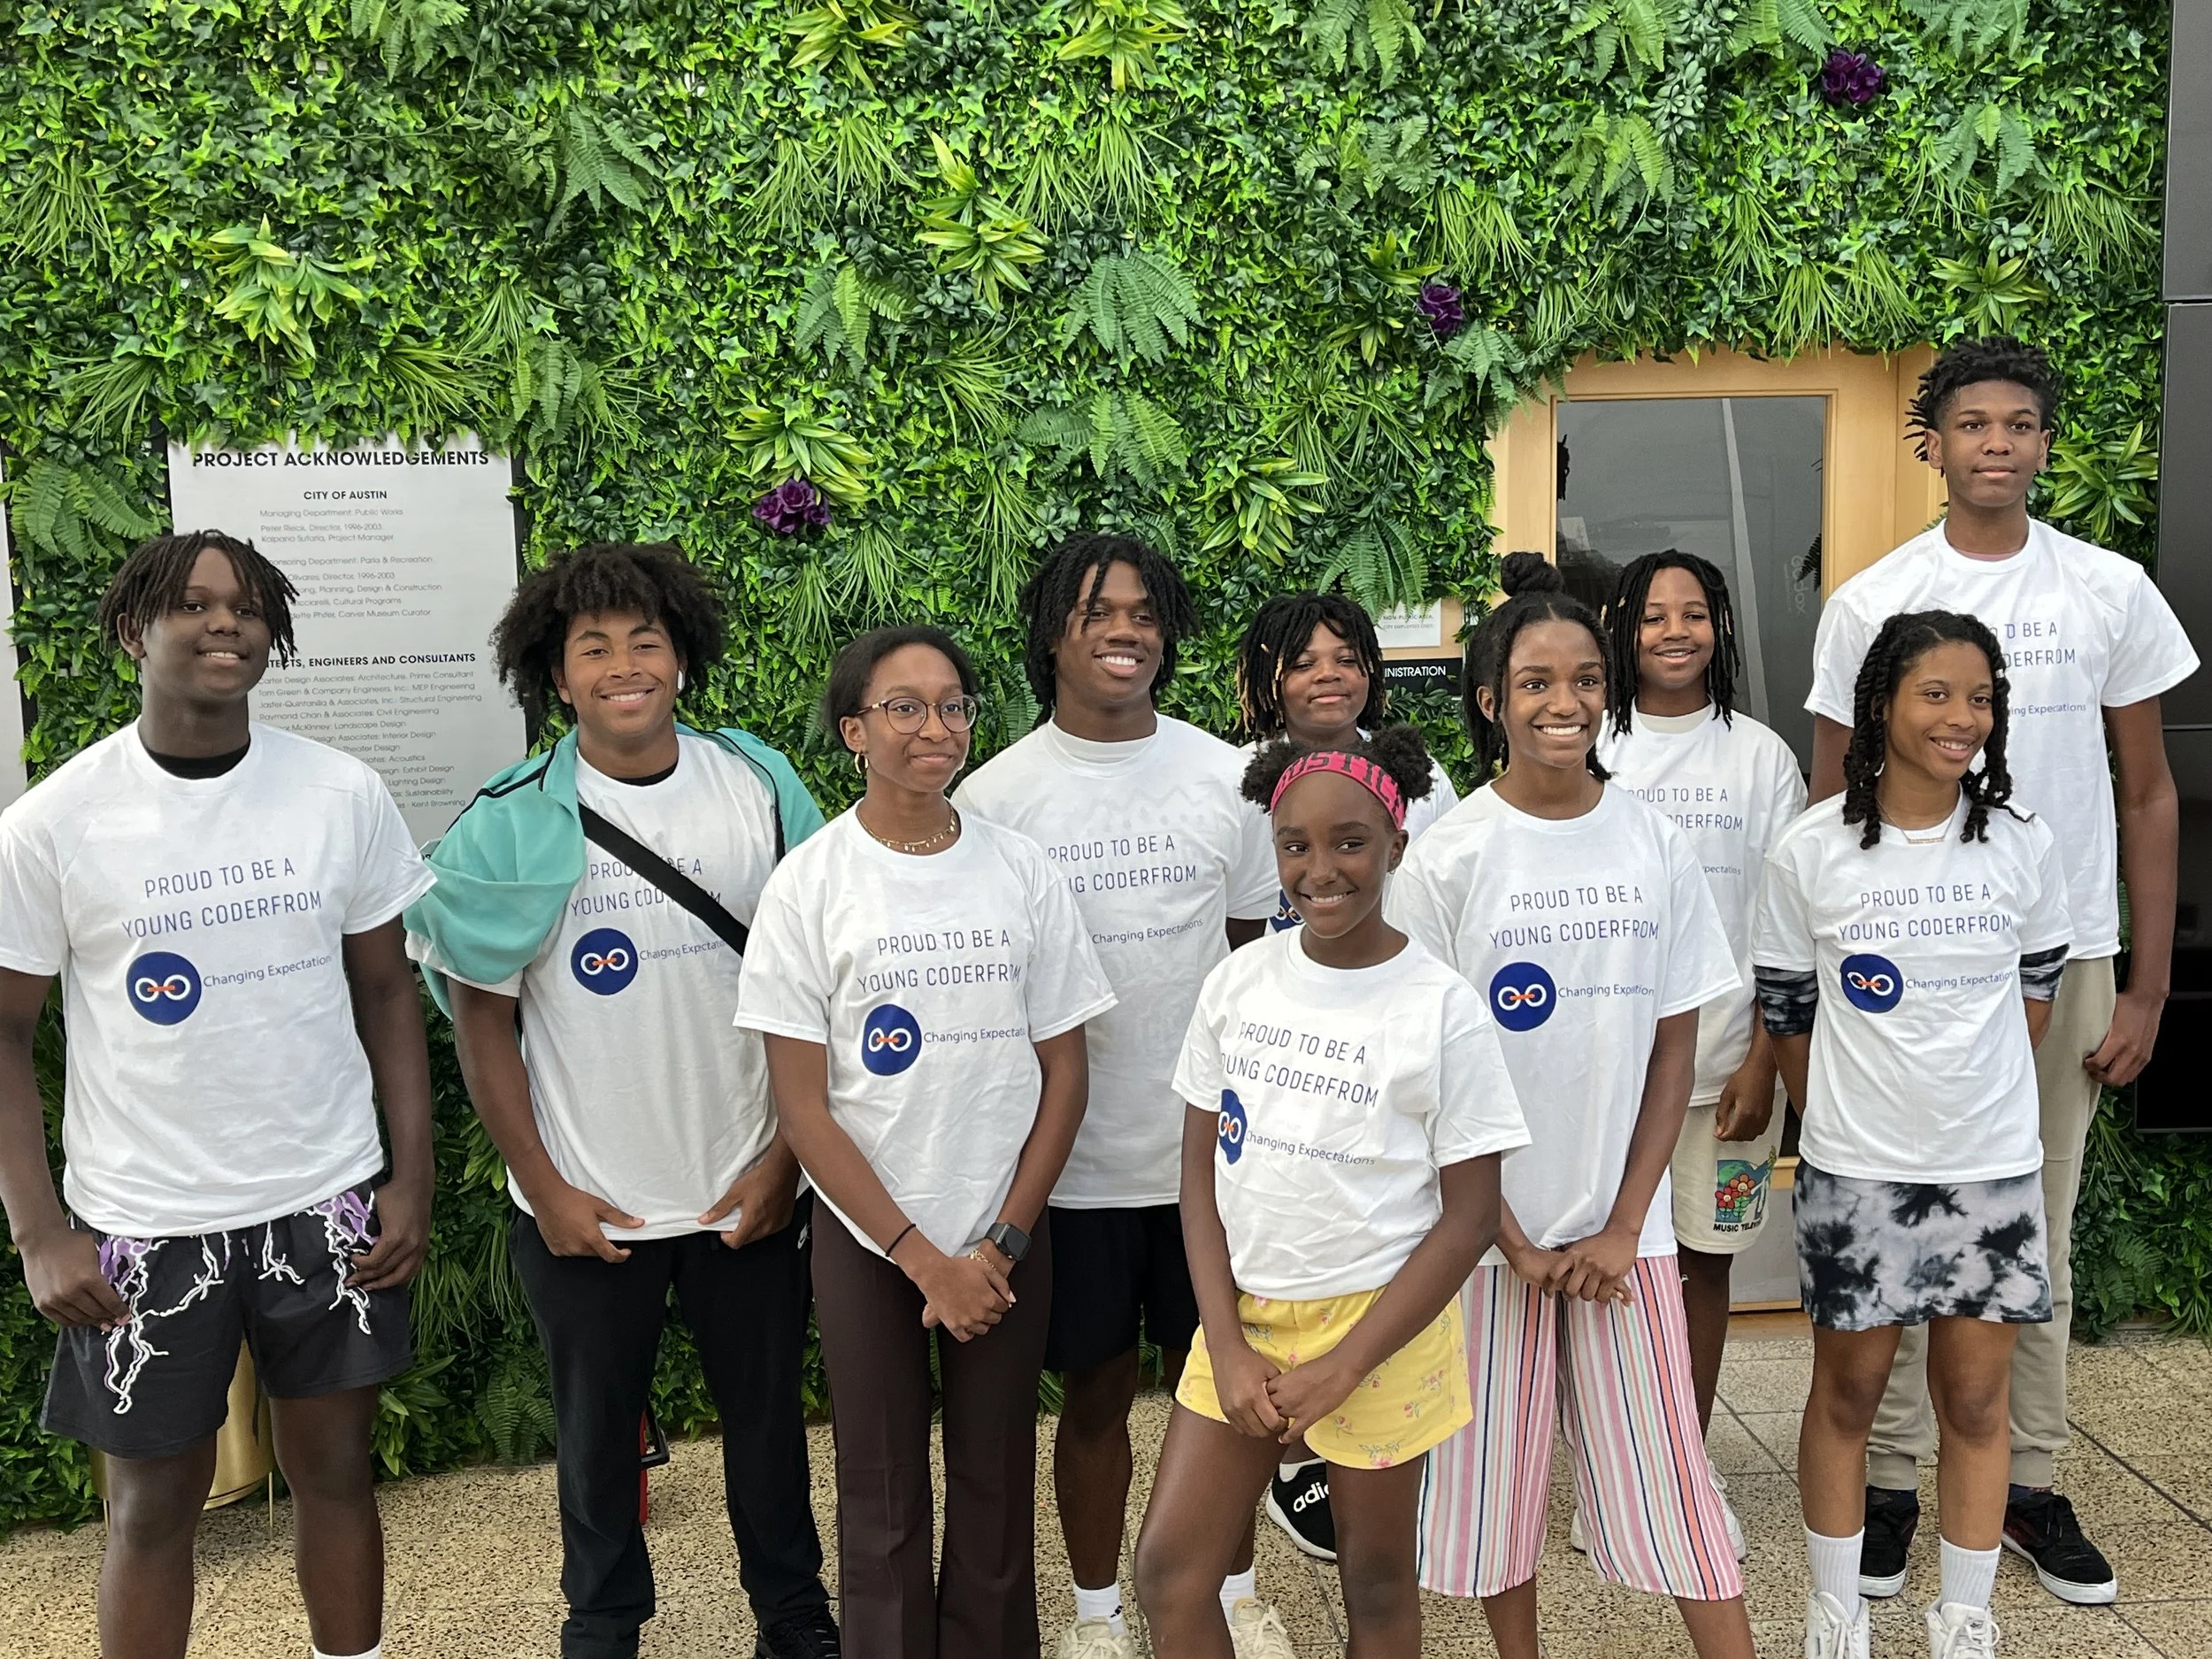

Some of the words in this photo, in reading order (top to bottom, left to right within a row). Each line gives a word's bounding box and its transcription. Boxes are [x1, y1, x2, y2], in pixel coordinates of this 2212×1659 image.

[193, 452, 278, 467] PROJECT
[284, 451, 488, 466] ACKNOWLEDGEMENTS
[303, 491, 328, 500] CITY
[349, 490, 388, 499] AUSTIN
[259, 510, 302, 518] Managing
[328, 534, 355, 543] Project
[357, 534, 395, 543] Manager
[2023, 622, 2042, 638] BE
[2049, 622, 2057, 635] A
[267, 658, 305, 669] TECTS,
[309, 657, 368, 666] ENGINEERS
[372, 656, 396, 664] AND
[399, 653, 476, 664] CONSULTANTS
[2003, 649, 2076, 668] DERFROM
[1384, 665, 1446, 678] INISTRATION
[284, 676, 311, 685] Design
[311, 687, 351, 695] Company
[431, 683, 475, 692] Engineering
[437, 695, 482, 703] Engineering
[259, 712, 298, 721] Raymond
[300, 710, 322, 719] Chan
[394, 708, 440, 717] Engineering
[334, 721, 378, 730] Landscape
[380, 720, 407, 729] Design
[1672, 788, 1689, 802] TO
[1695, 787, 1714, 802] BE
[1720, 788, 1728, 802] A
[1666, 814, 1743, 831] DERFROM
[1048, 841, 1104, 863] PROUD
[1110, 839, 1131, 856] TO
[1137, 835, 1158, 854] BE
[1165, 834, 1175, 851] A
[589, 861, 634, 879] PROU
[693, 858, 702, 874] A
[144, 870, 212, 898] PROUD
[219, 864, 244, 886] TO
[251, 859, 277, 880] BE
[284, 857, 296, 876] A
[1093, 864, 1196, 891] CODERFROM
[1510, 889, 1570, 912] PROUD
[1576, 887, 1598, 905] TO
[1605, 885, 1628, 903] BE
[1634, 886, 1643, 903] A
[1861, 888, 1919, 908] PROUD
[1925, 886, 1946, 902] TO
[1952, 883, 1975, 902] BE
[1981, 883, 1991, 900] A
[571, 892, 629, 917] YOUNG
[122, 910, 193, 940] YOUNG
[201, 890, 322, 926] CODERFROM
[1489, 926, 1552, 949] YOUNG
[1560, 919, 1659, 941] CODERFROM
[1839, 921, 1900, 941] YOUNG
[1908, 914, 2012, 937] CODERFROM
[878, 933, 937, 956] PROUD
[942, 931, 964, 950] TO
[972, 929, 995, 948] BE
[1001, 929, 1010, 947] A
[1092, 930, 1144, 945] Changing
[203, 968, 265, 987] Changing
[857, 969, 918, 993] YOUNG
[1905, 977, 1957, 991] Changing
[1557, 985, 1610, 998] Changing
[923, 1028, 978, 1043] Changing
[1238, 1021, 1292, 1048] PROUD
[1298, 1033, 1320, 1055] TO
[1325, 1039, 1350, 1061] BE
[1353, 1045, 1365, 1064] A
[1221, 1053, 1261, 1079] OUNG
[1264, 1064, 1379, 1108] CODERFROM
[1246, 1130, 1295, 1156] Changing
[1298, 1143, 1375, 1165] Expectations
[1713, 1223, 1739, 1233] MUSIC
